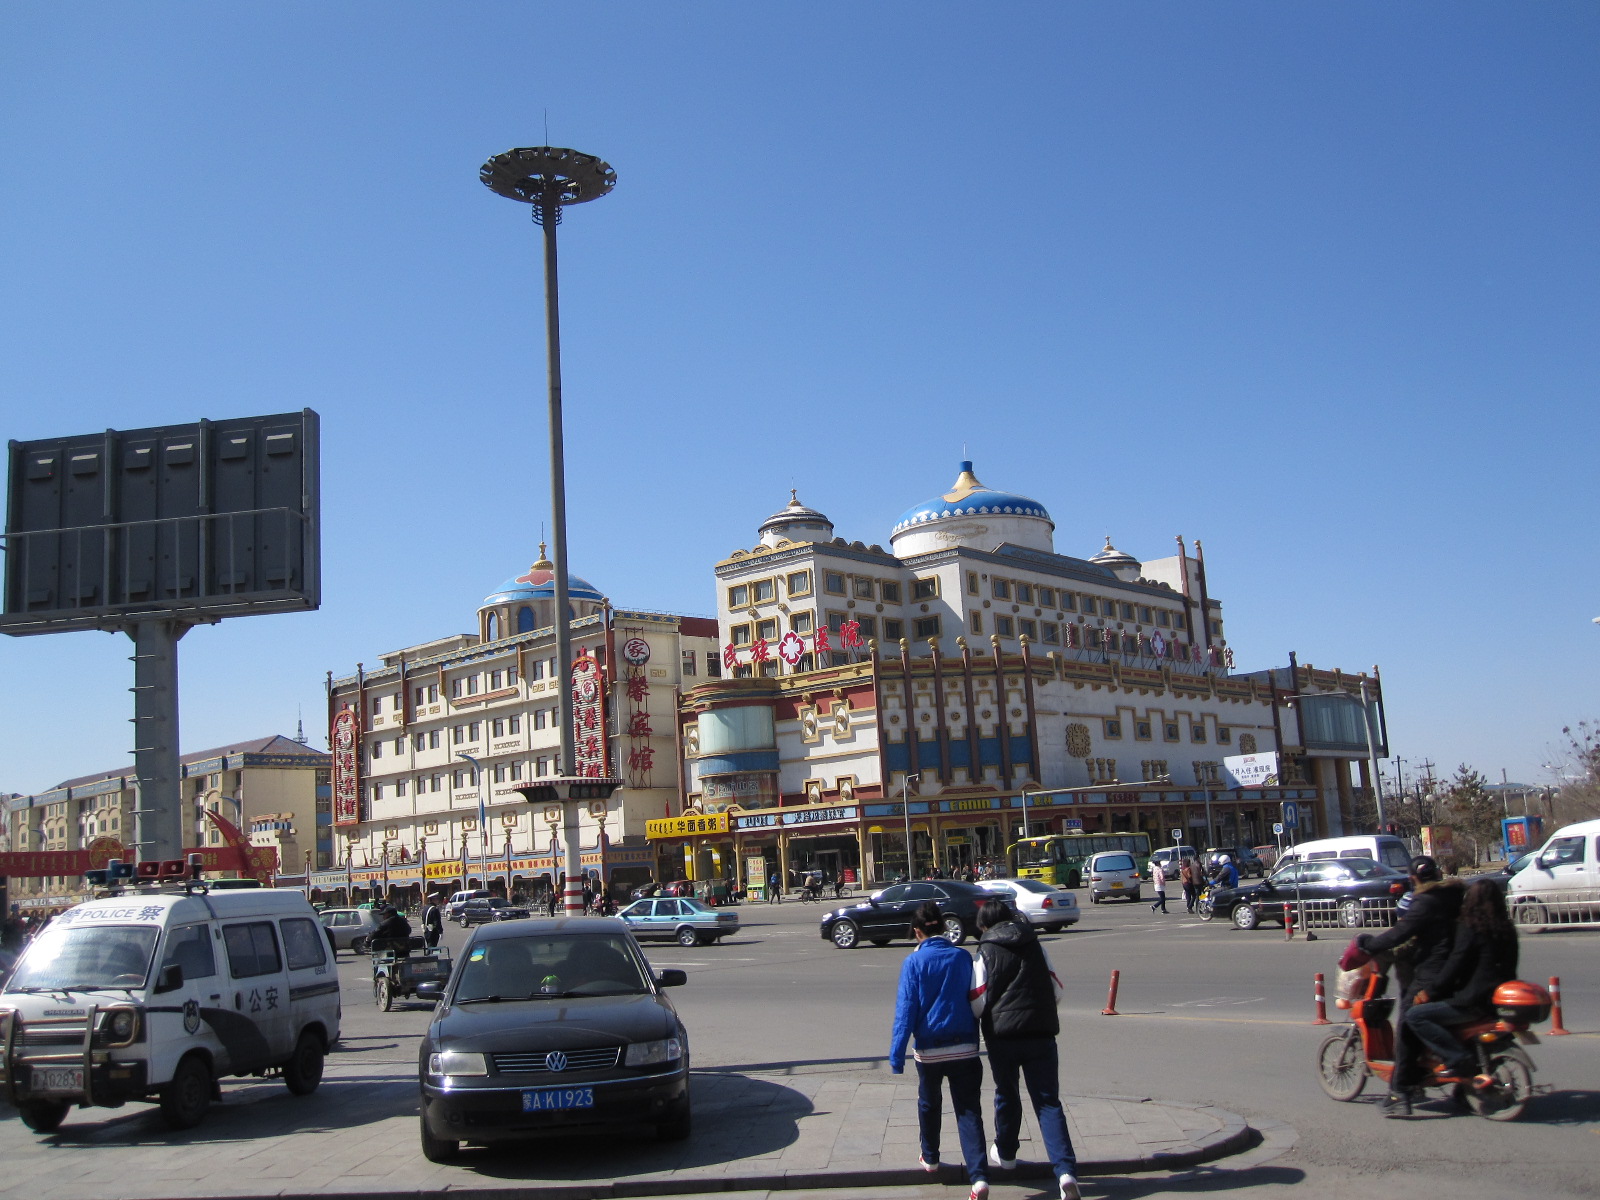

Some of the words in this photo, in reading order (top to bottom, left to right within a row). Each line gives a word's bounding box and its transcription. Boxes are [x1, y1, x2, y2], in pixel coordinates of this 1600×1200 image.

[724, 638, 770, 669] 民族
[813, 620, 864, 655] 医院
[677, 818, 717, 833] 华面香粥
[80, 908, 137, 920] POLICE
[136, 905, 165, 921] 察
[249, 986, 279, 1013] 公安
